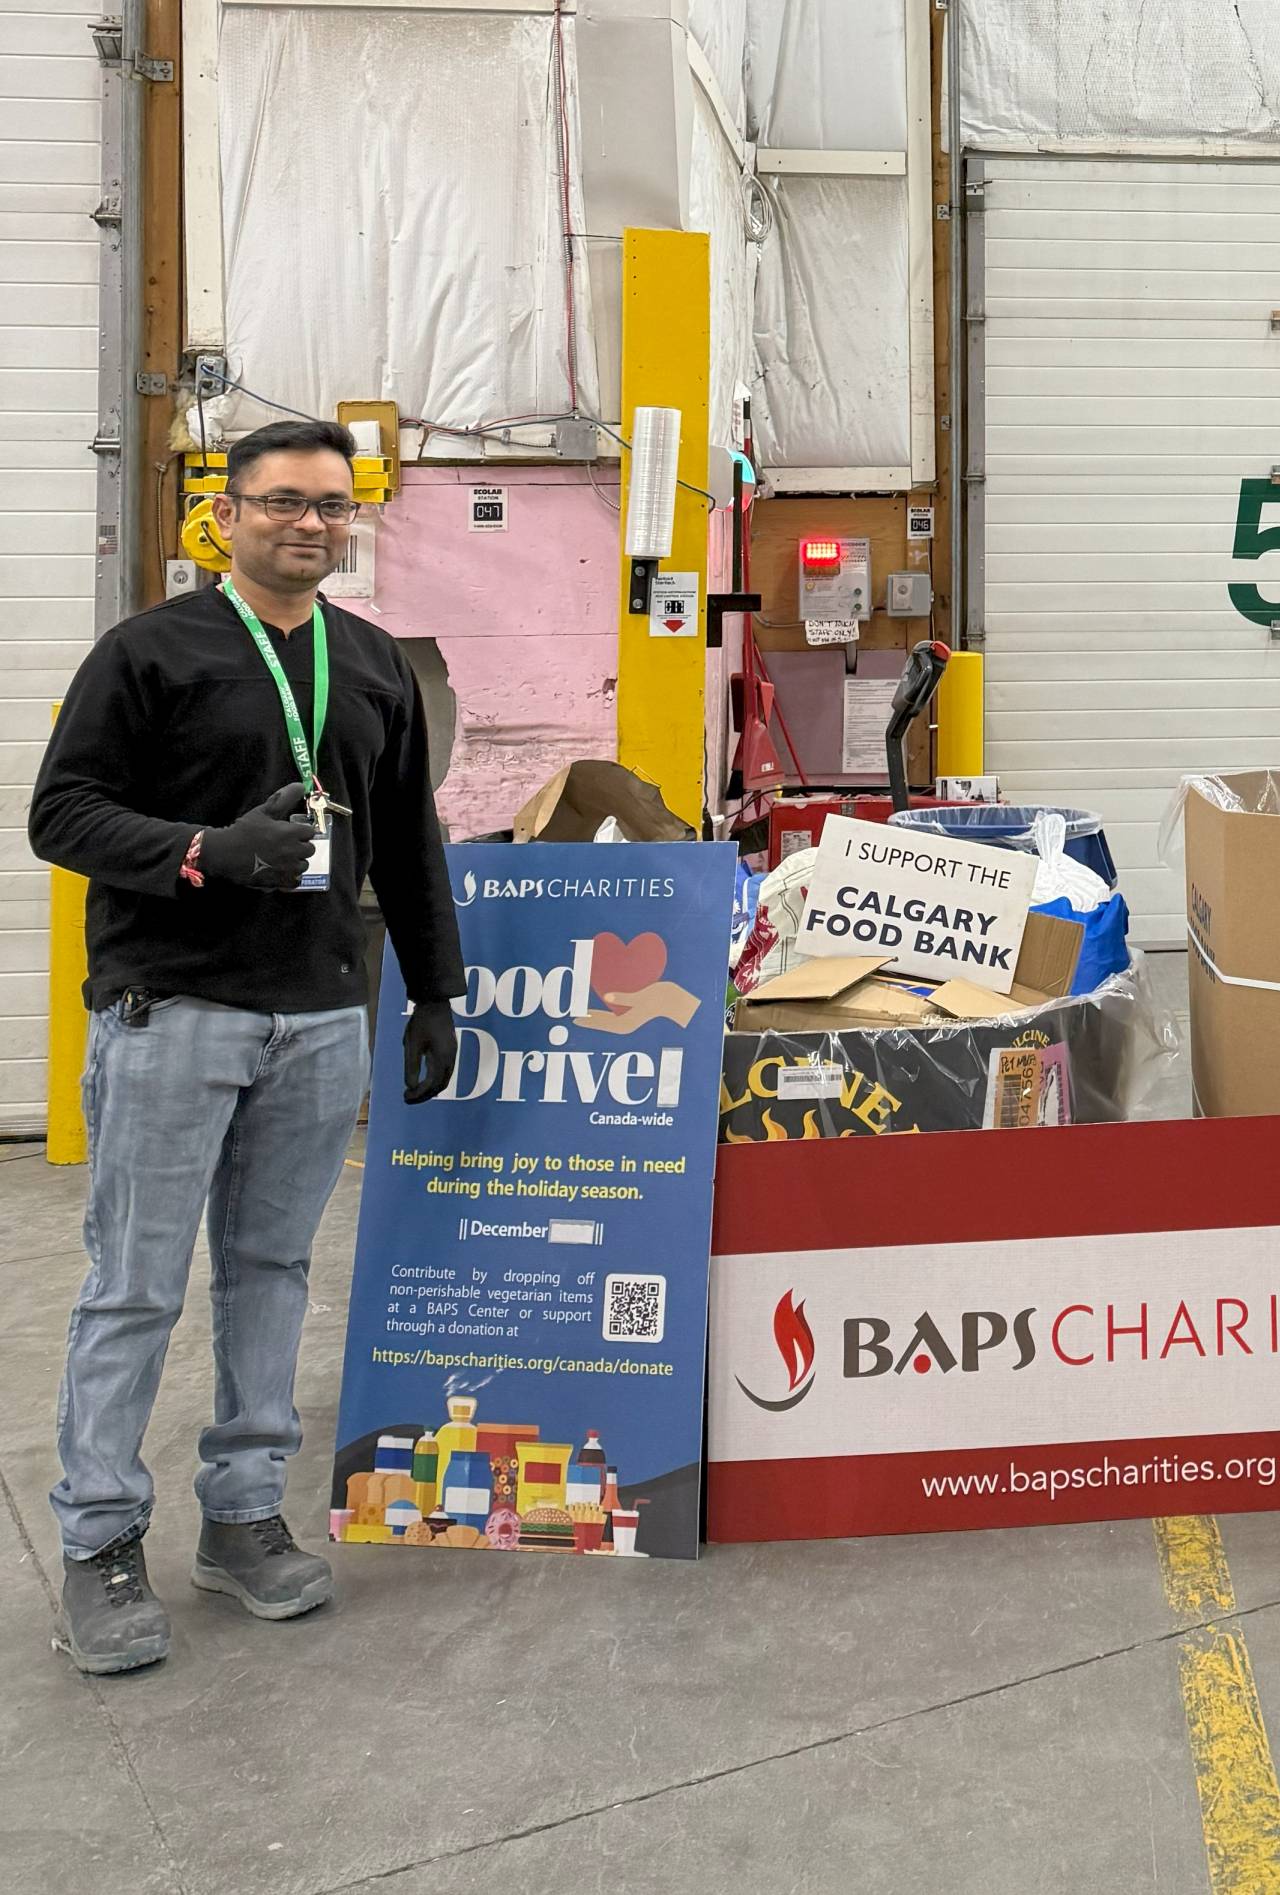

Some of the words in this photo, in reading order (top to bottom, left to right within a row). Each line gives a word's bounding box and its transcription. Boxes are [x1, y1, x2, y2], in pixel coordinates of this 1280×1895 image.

[477, 506, 500, 518] 047
[912, 520, 929, 530] 046
[255, 632, 280, 667] STAFF
[293, 736, 312, 778] STAFF
[844, 839, 852, 857] I
[858, 842, 963, 881] SUPPORT
[967, 863, 1012, 889] THE
[483, 879, 543, 898] BAPS
[547, 878, 674, 897] CHARITIES
[836, 886, 999, 936] CALGARY
[806, 909, 903, 947] FOOD
[913, 930, 1013, 970] BANK
[402, 939, 594, 1018] ood
[433, 1025, 683, 1107] Drive
[589, 1111, 673, 1126] Canada-wide
[391, 1149, 454, 1173] Helping
[459, 1151, 504, 1173] bring
[512, 1154, 539, 1175] joy
[544, 1156, 562, 1172] to
[568, 1155, 614, 1173] those
[621, 1156, 636, 1173] in
[643, 1156, 685, 1174] need
[426, 1177, 480, 1197] during
[487, 1179, 514, 1196] the
[517, 1180, 578, 1201] holiday
[581, 1186, 643, 1200] season.
[470, 1221, 548, 1239] December
[391, 1264, 456, 1281] Contribute
[472, 1268, 488, 1283] by
[503, 1269, 561, 1286] dropping
[577, 1272, 595, 1286] off
[389, 1284, 481, 1302] non-perishable
[487, 1289, 552, 1305] vegetarian
[559, 1290, 593, 1304] items
[388, 1303, 400, 1314] at
[409, 1306, 416, 1314] a
[426, 1303, 458, 1316] BAPS
[468, 1305, 509, 1318] Center
[519, 1309, 533, 1319] or
[543, 1308, 592, 1323] support
[386, 1320, 435, 1337] through
[438, 1324, 445, 1334] a
[448, 1321, 504, 1338] donation
[506, 1325, 519, 1338] at
[842, 1307, 1038, 1379] BAPS
[372, 1348, 673, 1376] https://bapscharities.org/canada/donate
[921, 1453, 1277, 1502] www.bapscharities.org
